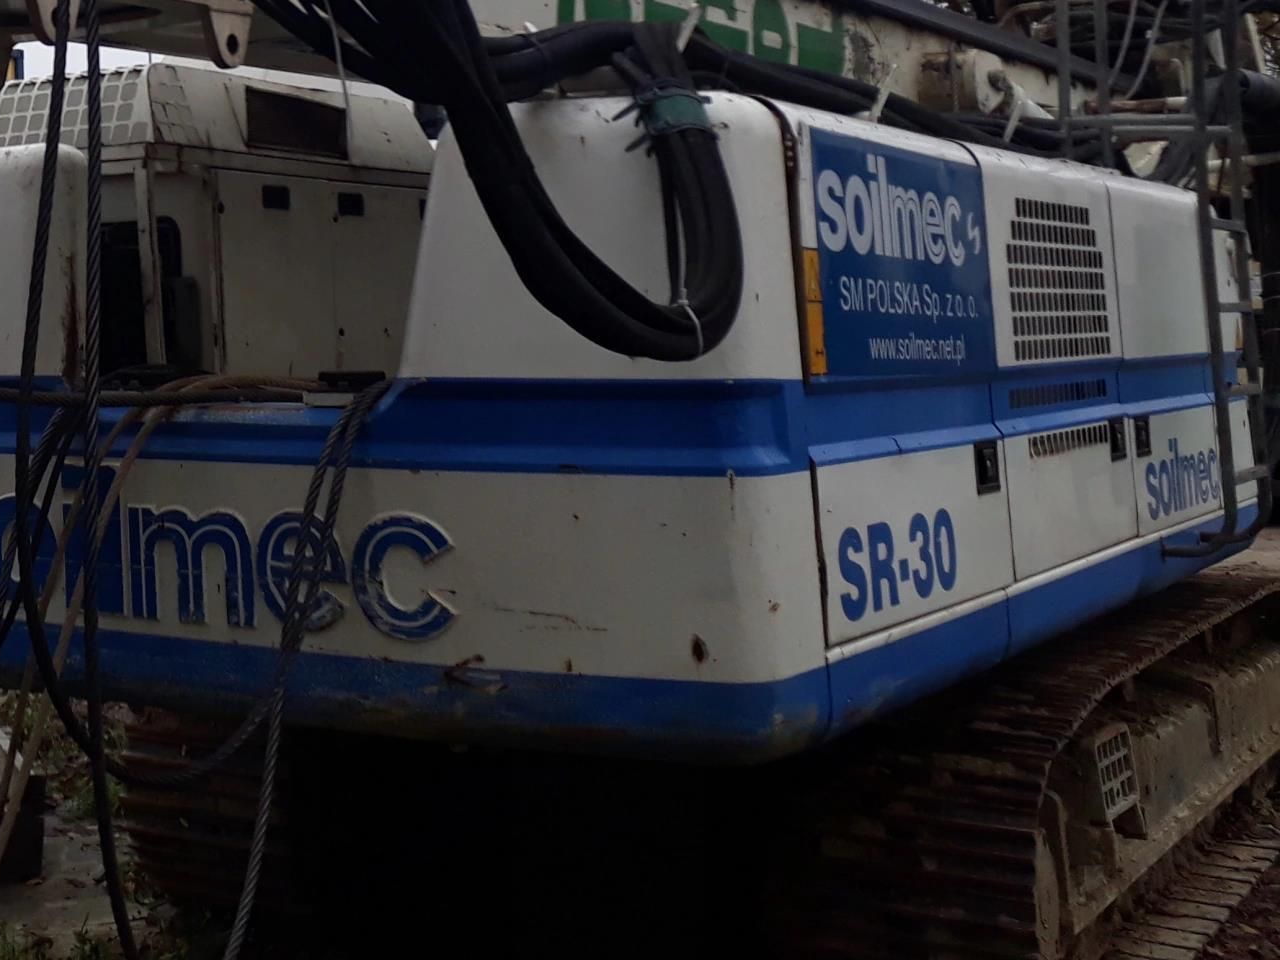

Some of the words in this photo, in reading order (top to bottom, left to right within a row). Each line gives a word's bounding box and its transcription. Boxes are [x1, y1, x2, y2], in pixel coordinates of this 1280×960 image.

[817, 154, 965, 266] soilmec
[840, 275, 864, 311] SM
[867, 278, 922, 316] POLSKA
[922, 283, 945, 324] Sp.
[869, 332, 966, 366] www.soilmec.net.pl
[1145, 437, 1220, 521] soilmec
[837, 507, 958, 623] SR-30
